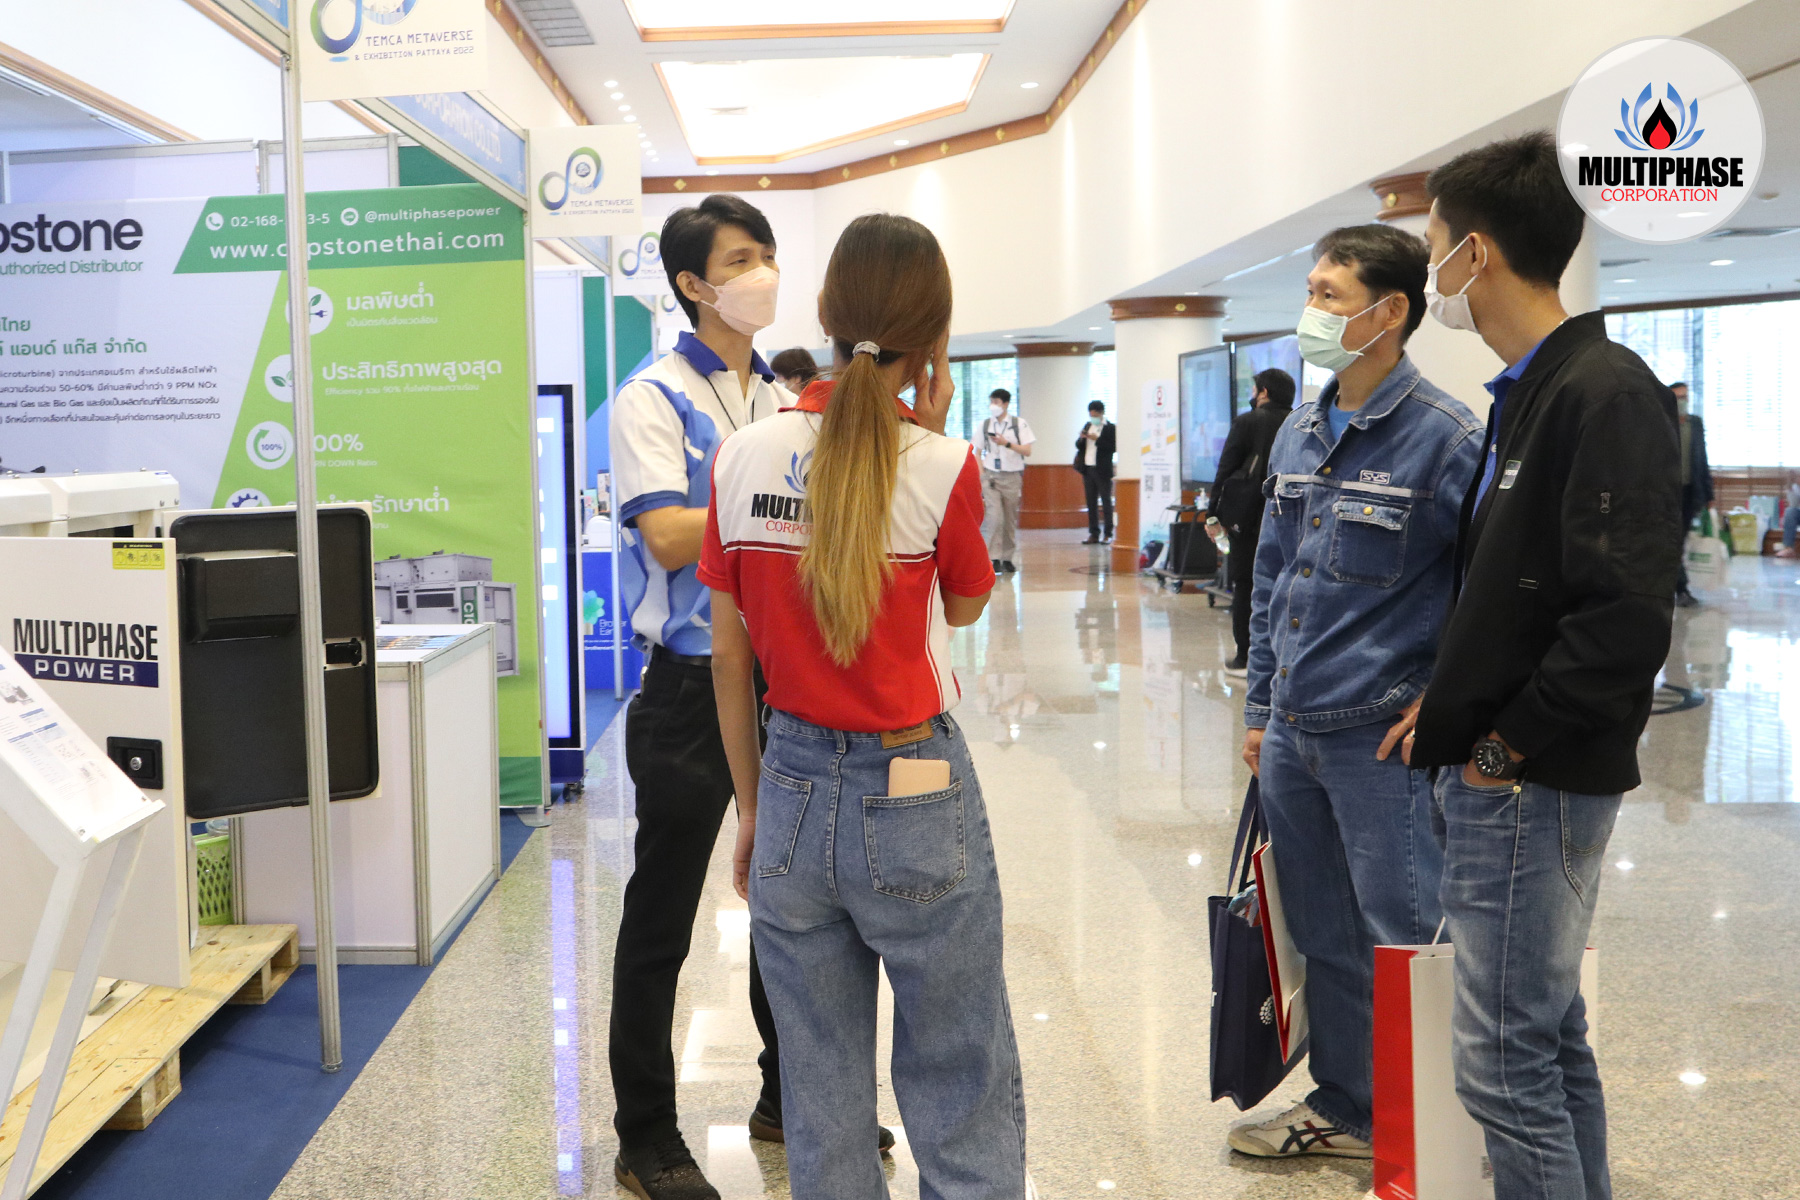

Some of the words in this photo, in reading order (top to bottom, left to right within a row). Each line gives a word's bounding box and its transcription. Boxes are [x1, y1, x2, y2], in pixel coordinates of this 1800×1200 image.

[366, 35, 403, 47] TEMCA
[407, 30, 474, 44] METAVERSE
[364, 50, 413, 60] EXHIBITION
[416, 48, 450, 57] PATTAYA
[453, 46, 474, 55] 2022
[595, 198, 634, 207] METAVERSE
[365, 206, 501, 223] @multiphasepower
[209, 231, 504, 261] www.cpstonethai.com
[70, 259, 143, 274] Distributor
[346, 282, 434, 311] มลพิษต่ำ
[0, 317, 31, 332] ไทย
[10, 340, 56, 356] แอนด์
[63, 338, 98, 355] แก๊ส
[104, 337, 147, 354] จำกัด
[0, 370, 55, 379] icroturbine)
[322, 360, 503, 382] ประสิทธิภาพสูงสุด
[59, 384, 94, 392] 50-60%
[198, 381, 217, 389] NOx
[261, 443, 283, 451] 100%
[313, 434, 364, 452] 00%
[14, 618, 158, 660] MULTIPHASE
[35, 659, 135, 682] POWER
